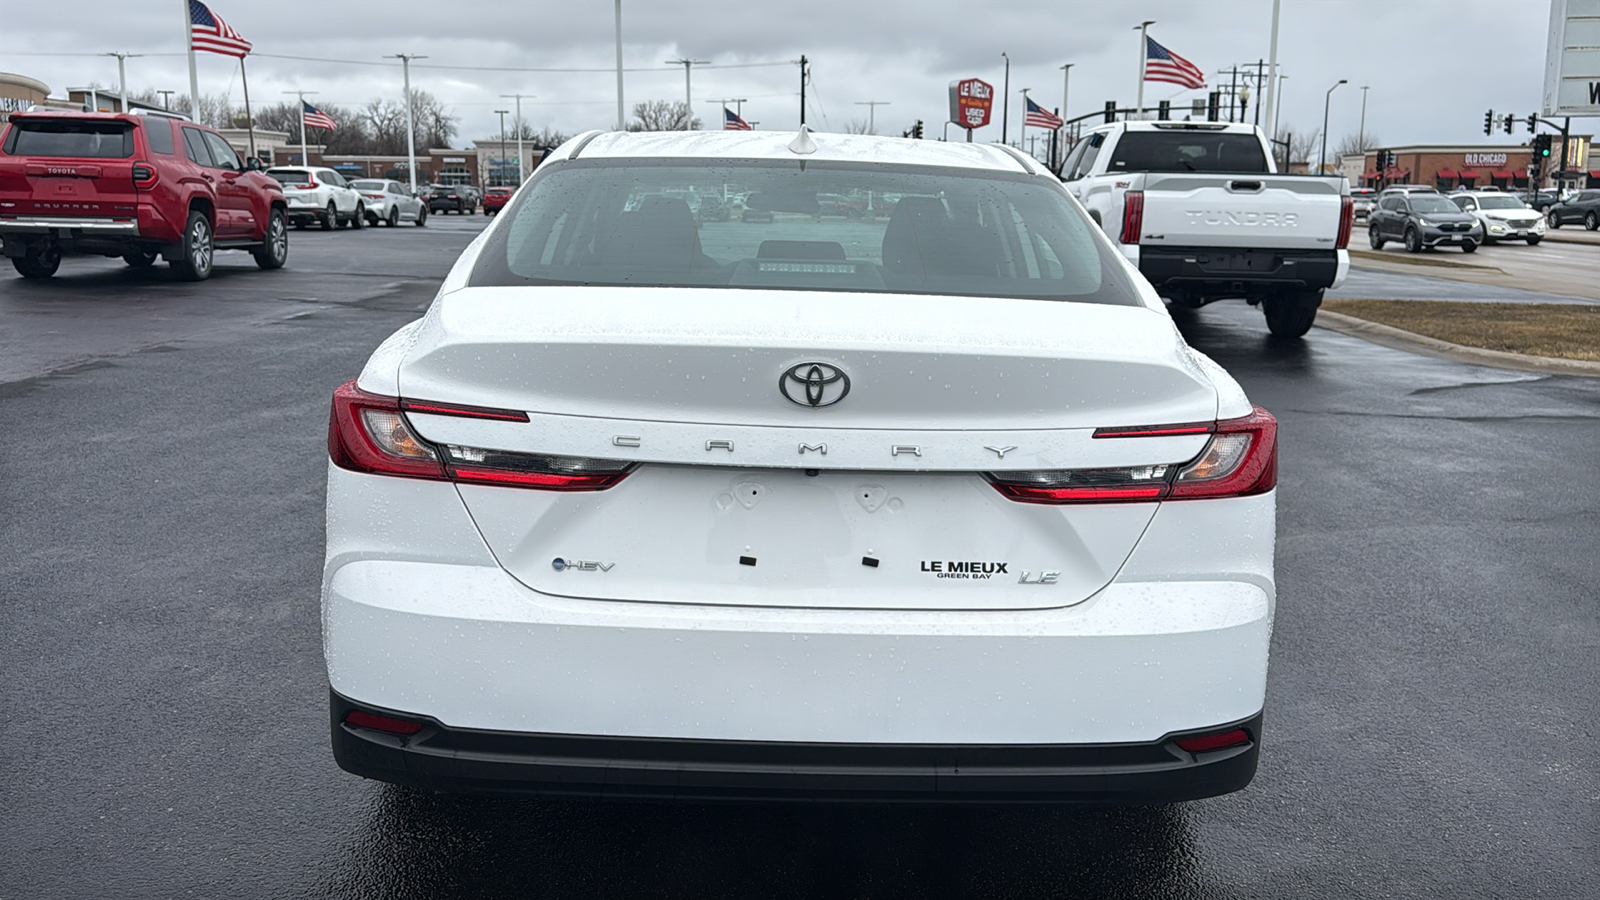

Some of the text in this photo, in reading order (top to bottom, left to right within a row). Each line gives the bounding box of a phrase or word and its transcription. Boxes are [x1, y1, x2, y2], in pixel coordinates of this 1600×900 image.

[961, 83, 969, 96] LE
[965, 107, 984, 117] USED
[1465, 153, 1507, 164] OLD CHICAGO
[1185, 210, 1298, 227] TUNDRA
[612, 435, 1018, 460] CAMRY
[921, 561, 1009, 574] LE MIEUX
[937, 572, 970, 580] GREEN
[1018, 571, 1060, 585] LE
